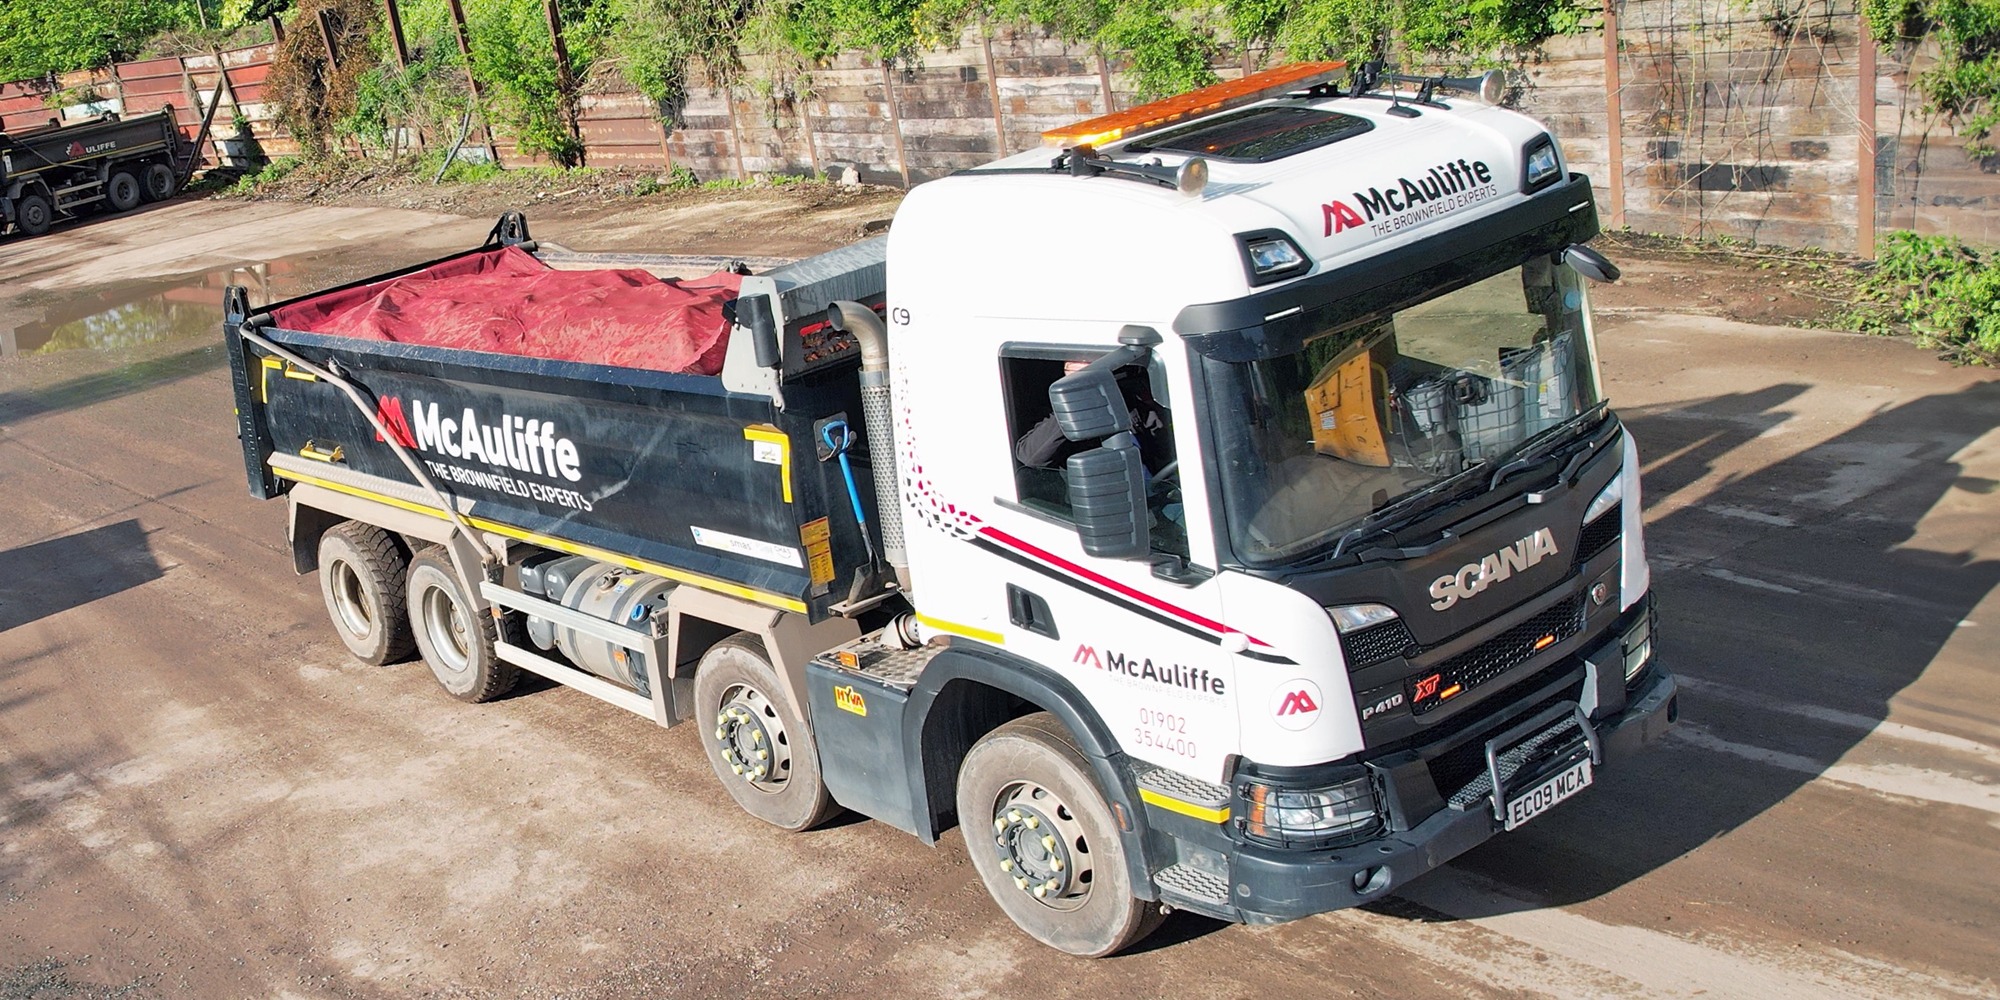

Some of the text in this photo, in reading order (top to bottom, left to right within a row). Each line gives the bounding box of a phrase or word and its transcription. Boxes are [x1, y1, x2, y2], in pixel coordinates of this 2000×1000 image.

[1352, 159, 1491, 221] McAuliffe
[1371, 184, 1498, 237] THE BROWNFIELD EXPERTS
[412, 399, 582, 482] McAuliffe
[424, 460, 593, 512] THE BROWNFIELD EXPERTS
[1429, 527, 1558, 612] SCANIA
[836, 687, 864, 708] HYVA
[1106, 650, 1226, 696] McAuliffe
[1413, 673, 1441, 703] XT
[1134, 728, 1197, 759] 354400
[1139, 707, 1187, 735] 01902
[1513, 766, 1586, 823] EC09 MCA
